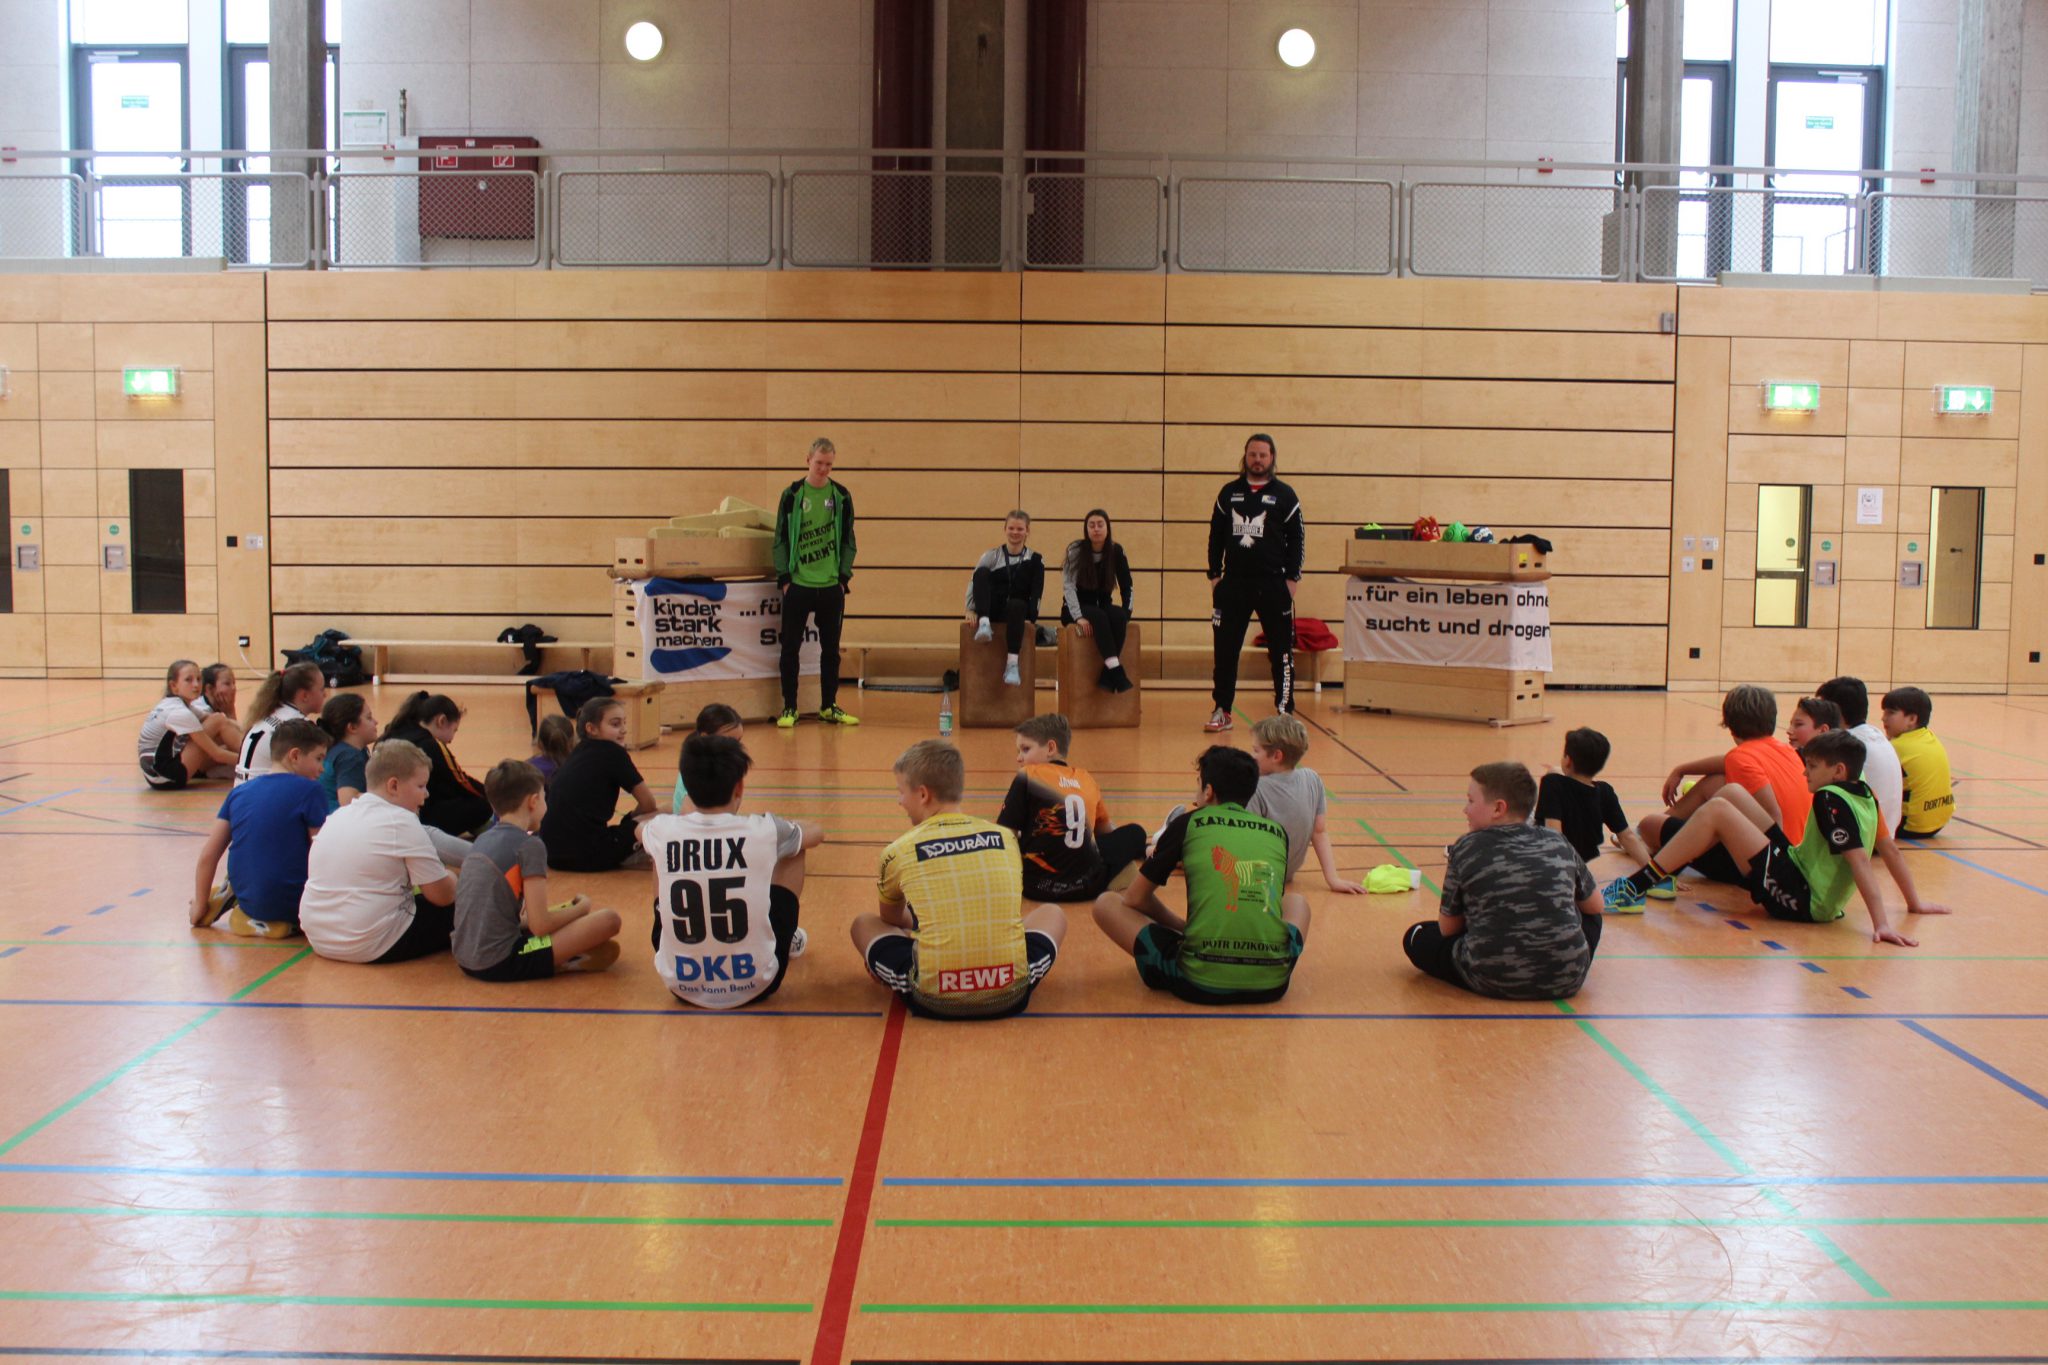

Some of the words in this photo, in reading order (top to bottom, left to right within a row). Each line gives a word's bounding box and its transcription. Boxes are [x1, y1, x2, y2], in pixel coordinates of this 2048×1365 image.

[800, 540, 835, 565] WARMU
[1406, 587, 1438, 604] ein
[1446, 589, 1508, 606] leben
[653, 599, 721, 617] kinder
[739, 600, 783, 616] ...fü
[655, 617, 722, 633] stark
[1366, 617, 1430, 632] sucht
[1439, 619, 1480, 635] und
[656, 632, 723, 647] machen
[244, 730, 265, 769] 1
[1064, 794, 1086, 849] 9
[1194, 816, 1283, 839] KARADUMAN
[944, 834, 1001, 853] DURAVIT
[666, 837, 748, 873] DRUX
[670, 876, 749, 945] 95
[675, 953, 757, 982] DKB
[678, 984, 698, 992] Das
[701, 984, 727, 994] kann
[729, 982, 756, 992] Bank
[941, 966, 1011, 991] REWE
